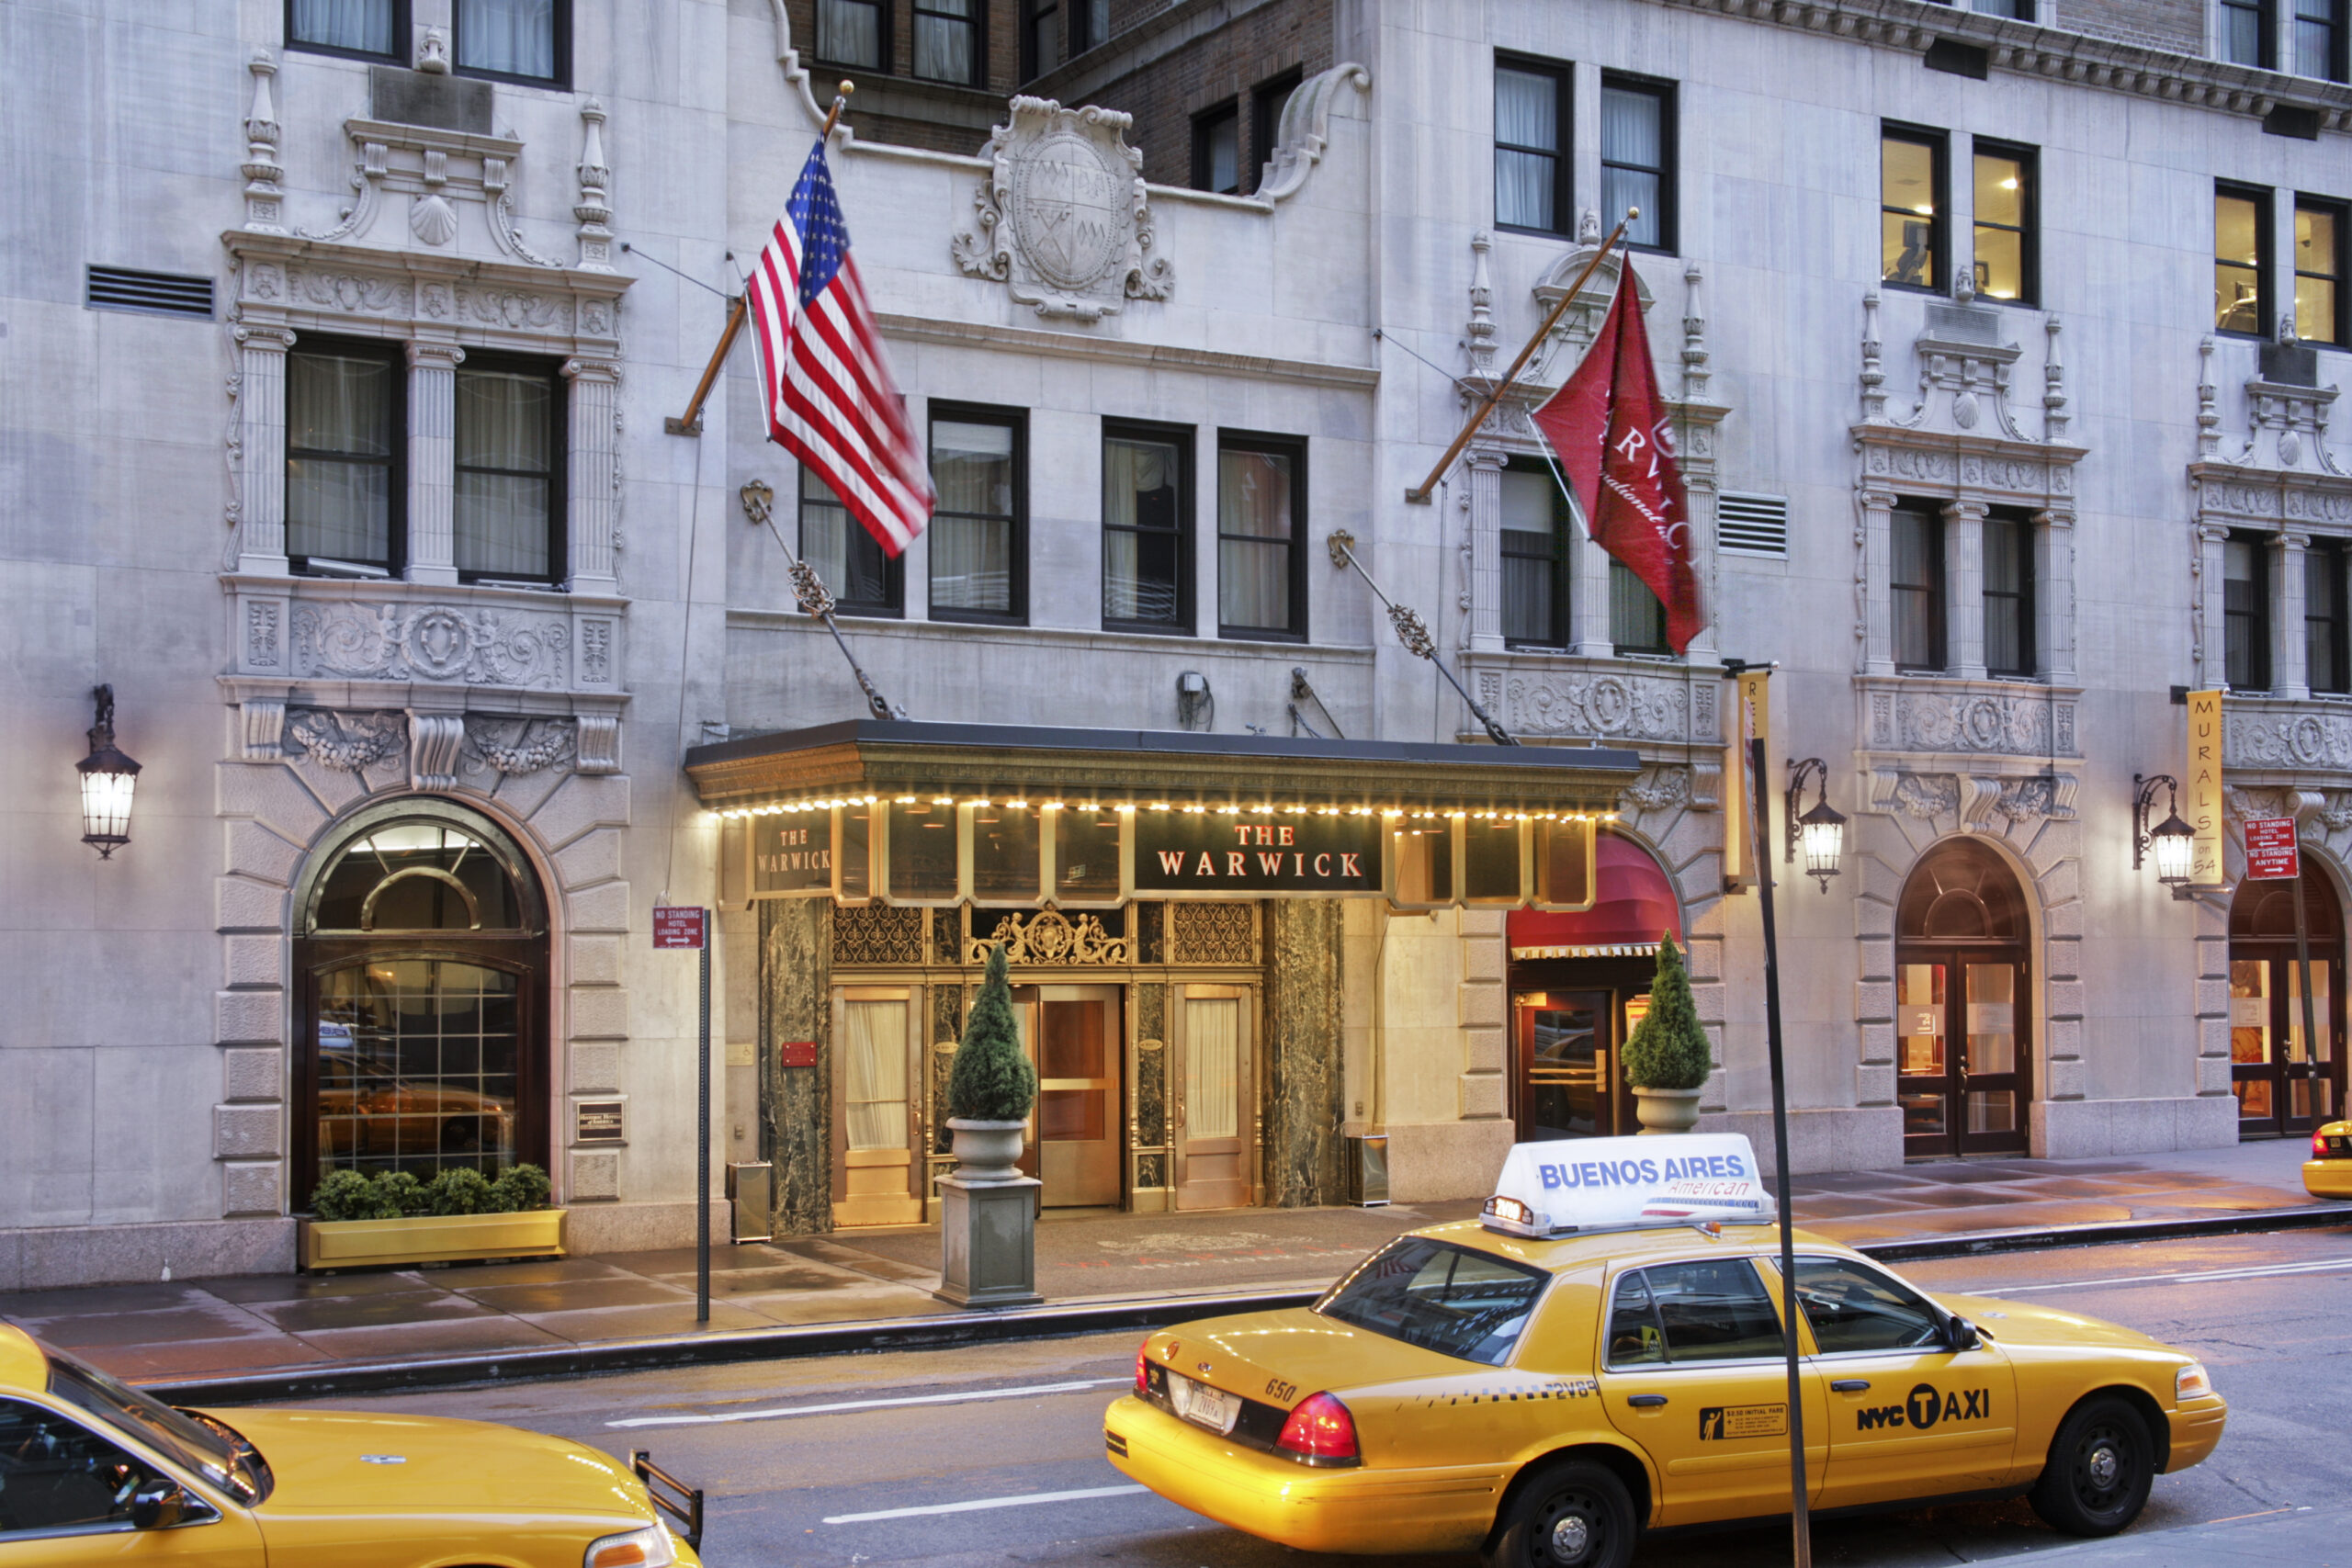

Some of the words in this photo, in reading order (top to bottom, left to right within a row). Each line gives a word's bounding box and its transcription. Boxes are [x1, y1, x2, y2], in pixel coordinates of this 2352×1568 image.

[2195, 701, 2213, 830] MURALS
[2259, 820, 2291, 829] STANDING
[779, 829, 808, 846] THE
[1234, 825, 1295, 846] THE
[2198, 845, 2211, 854] on
[2261, 850, 2293, 858] STANDING
[757, 849, 831, 873] WARWICK
[1157, 851, 1363, 877] WARWICK
[2194, 859, 2215, 874] 54
[2256, 858, 2290, 866] ANYTIME
[655, 910, 665, 919] NO
[668, 910, 700, 919] STANDING
[1539, 1158, 1659, 1190] BUENOS
[1664, 1155, 1745, 1182] AIRES
[1668, 1180, 1749, 1195] American
[1265, 1378, 1297, 1404] 650
[1553, 1380, 1600, 1399] 2V89
[1857, 1396, 1905, 1430] NYC
[1913, 1388, 1989, 1425] TAXI
